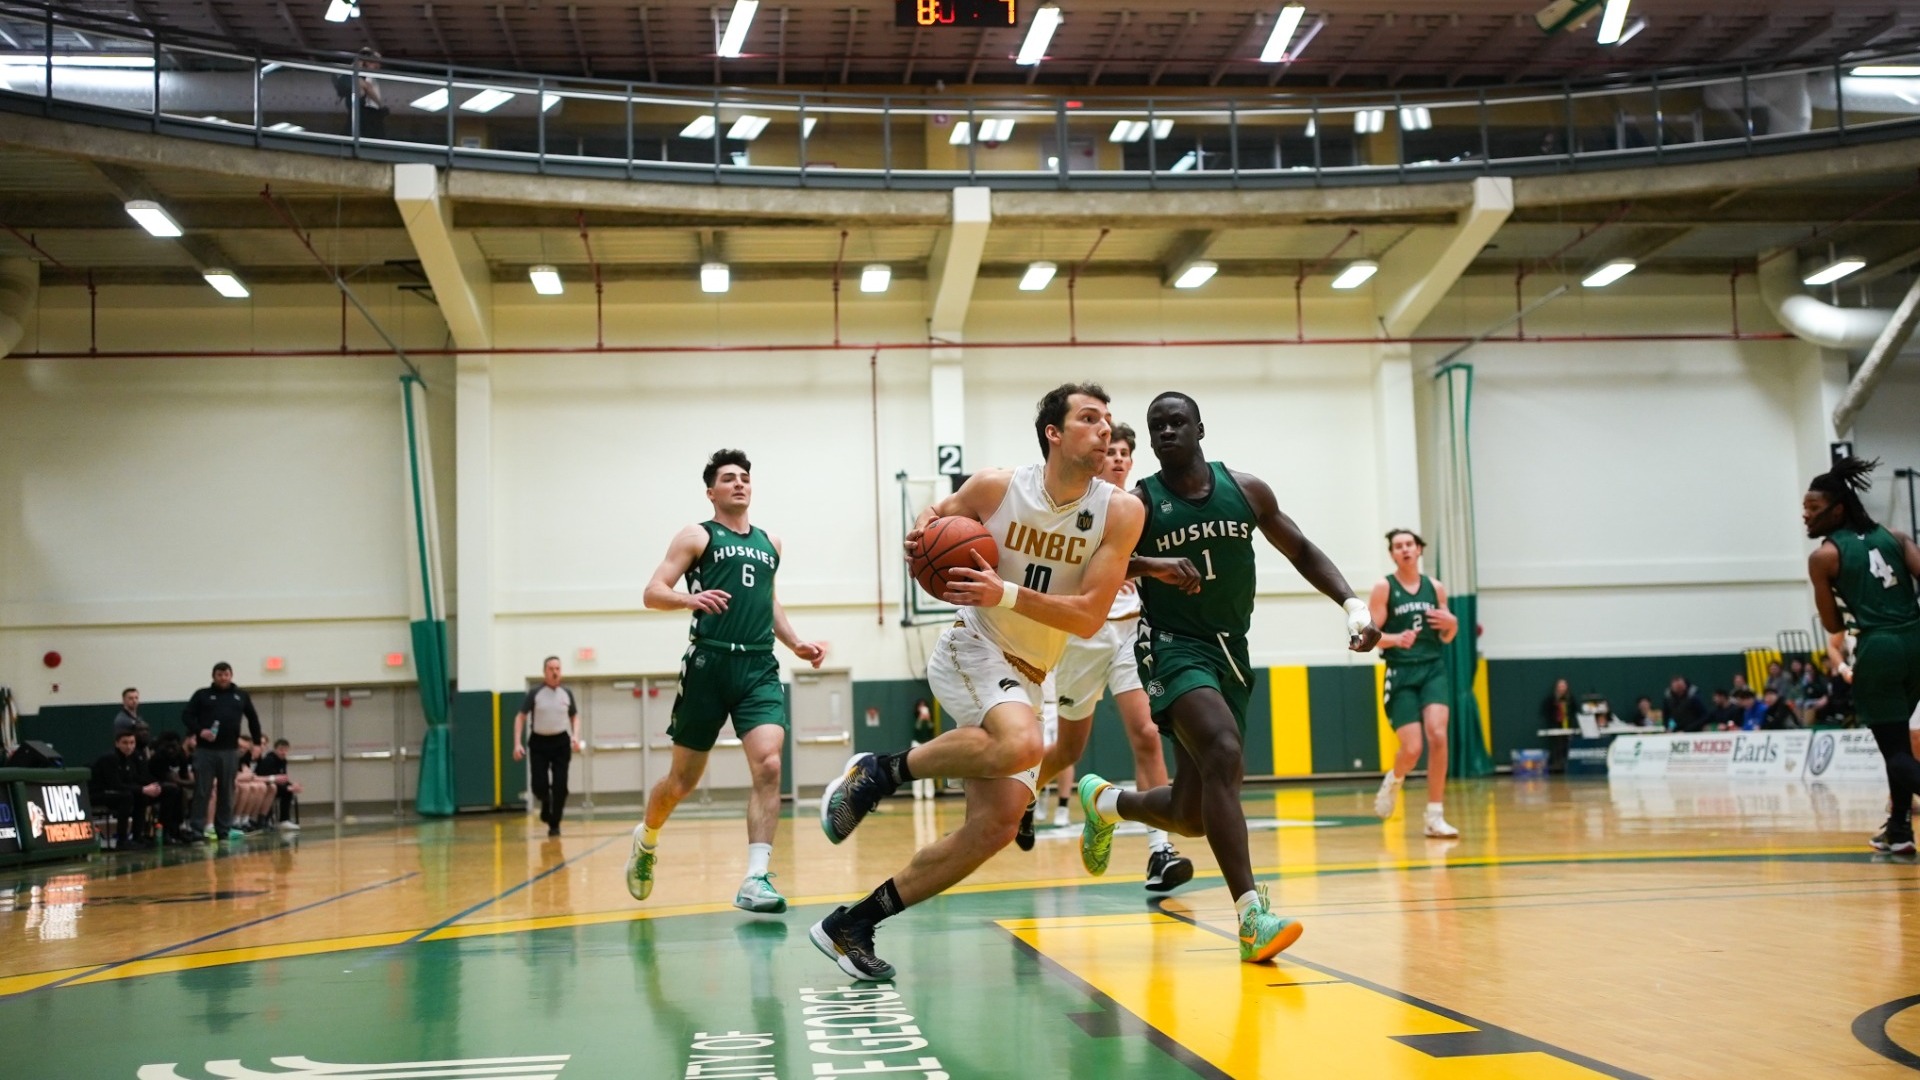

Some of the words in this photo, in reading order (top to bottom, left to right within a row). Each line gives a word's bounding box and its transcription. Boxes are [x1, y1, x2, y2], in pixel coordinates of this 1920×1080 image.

[940, 446, 961, 474] 2
[1004, 521, 1087, 565] UNBC
[1156, 520, 1249, 552] HUSKIES
[713, 545, 776, 569] HUSKIES
[1201, 549, 1217, 581] 1
[1868, 548, 1899, 589] 4
[742, 563, 756, 588] 6
[1023, 562, 1053, 594] 10
[1412, 613, 1423, 631] 2
[1733, 735, 1779, 763] Earls
[41, 784, 86, 822] UNBC
[799, 984, 929, 1055] GEORGE
[690, 1031, 775, 1050] OF
[685, 1055, 778, 1080] ITY
